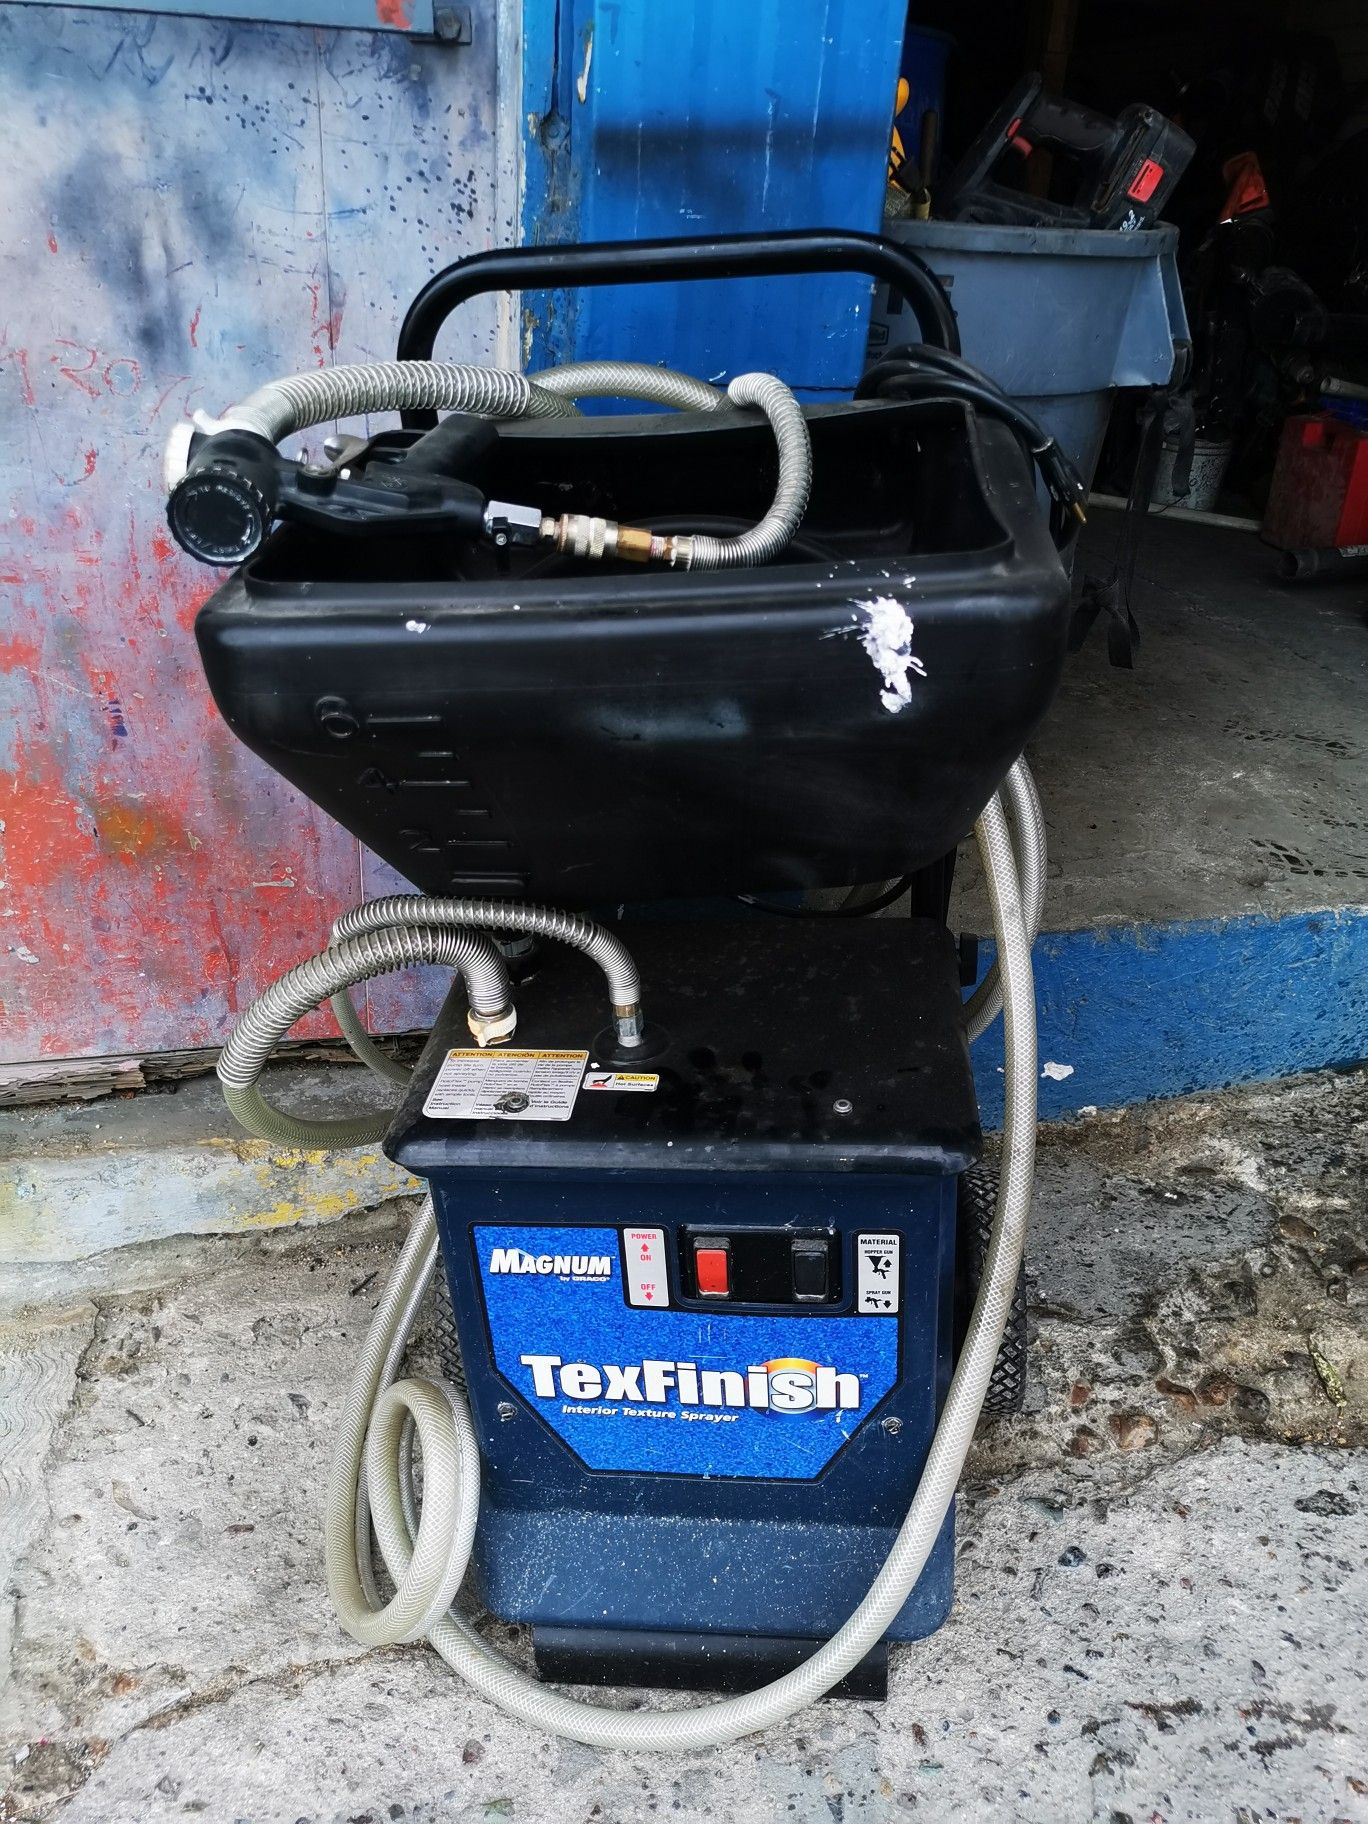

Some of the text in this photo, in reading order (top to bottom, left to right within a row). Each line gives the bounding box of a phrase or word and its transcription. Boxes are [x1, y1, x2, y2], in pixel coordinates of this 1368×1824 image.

[631, 1232, 657, 1240] POWER
[489, 1248, 611, 1275] MAGNUM
[640, 1283, 656, 1291] OFF
[520, 1354, 861, 1410] TexFinish
[561, 1405, 740, 1424] Interior Texture Sprayer
